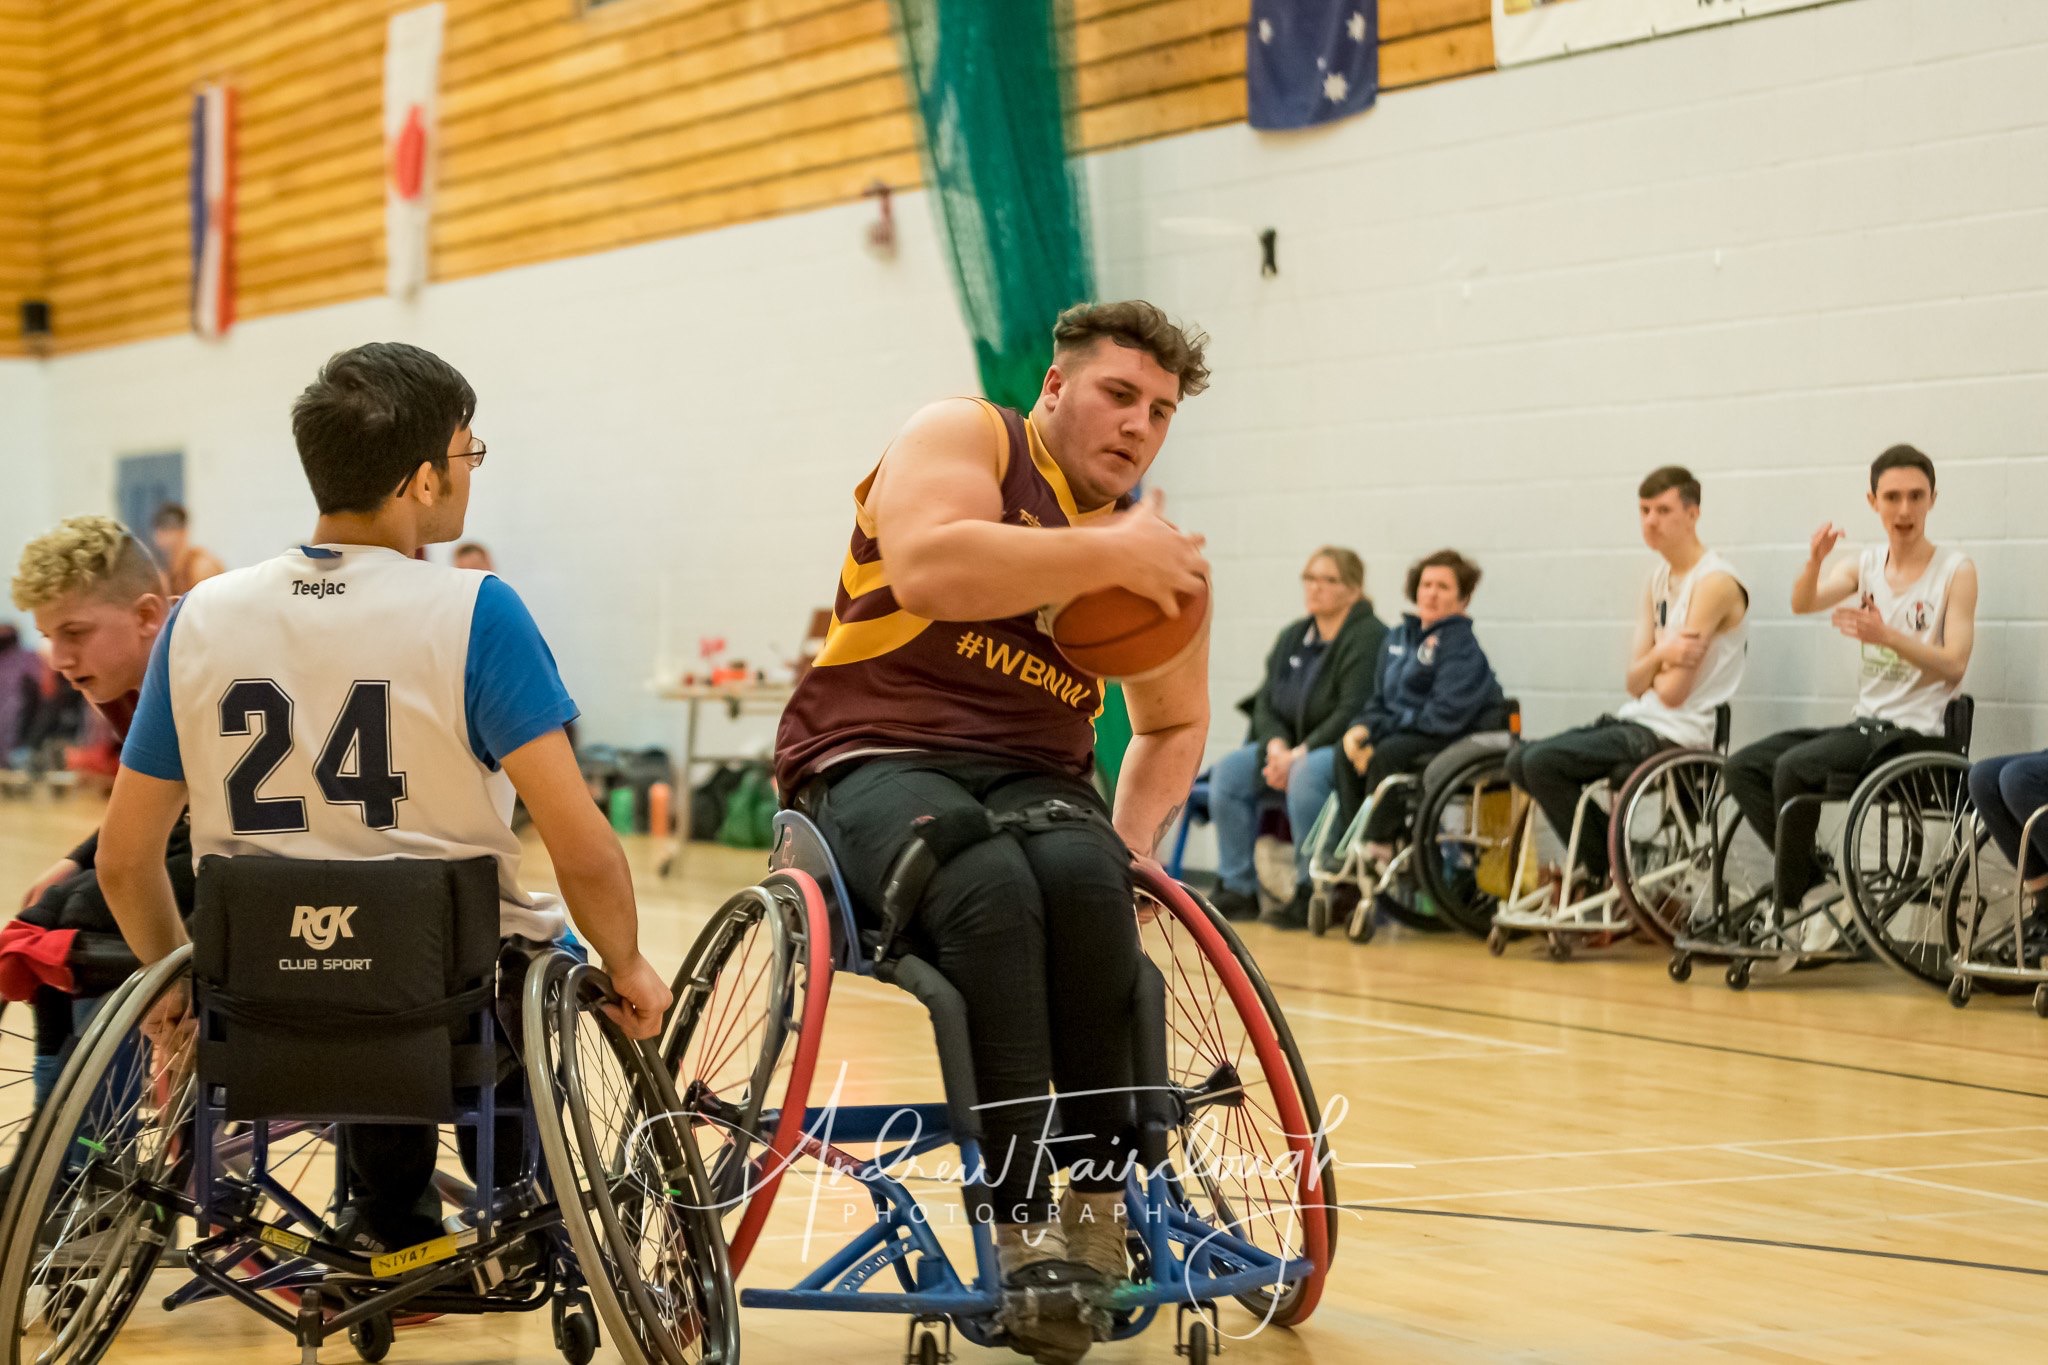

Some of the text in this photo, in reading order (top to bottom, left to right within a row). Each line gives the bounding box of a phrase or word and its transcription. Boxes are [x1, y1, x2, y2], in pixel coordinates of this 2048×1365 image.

[291, 578, 346, 600] Teejac
[218, 678, 408, 835] 24
[290, 905, 358, 950] RGK
[278, 958, 372, 970] CLUB SPORT
